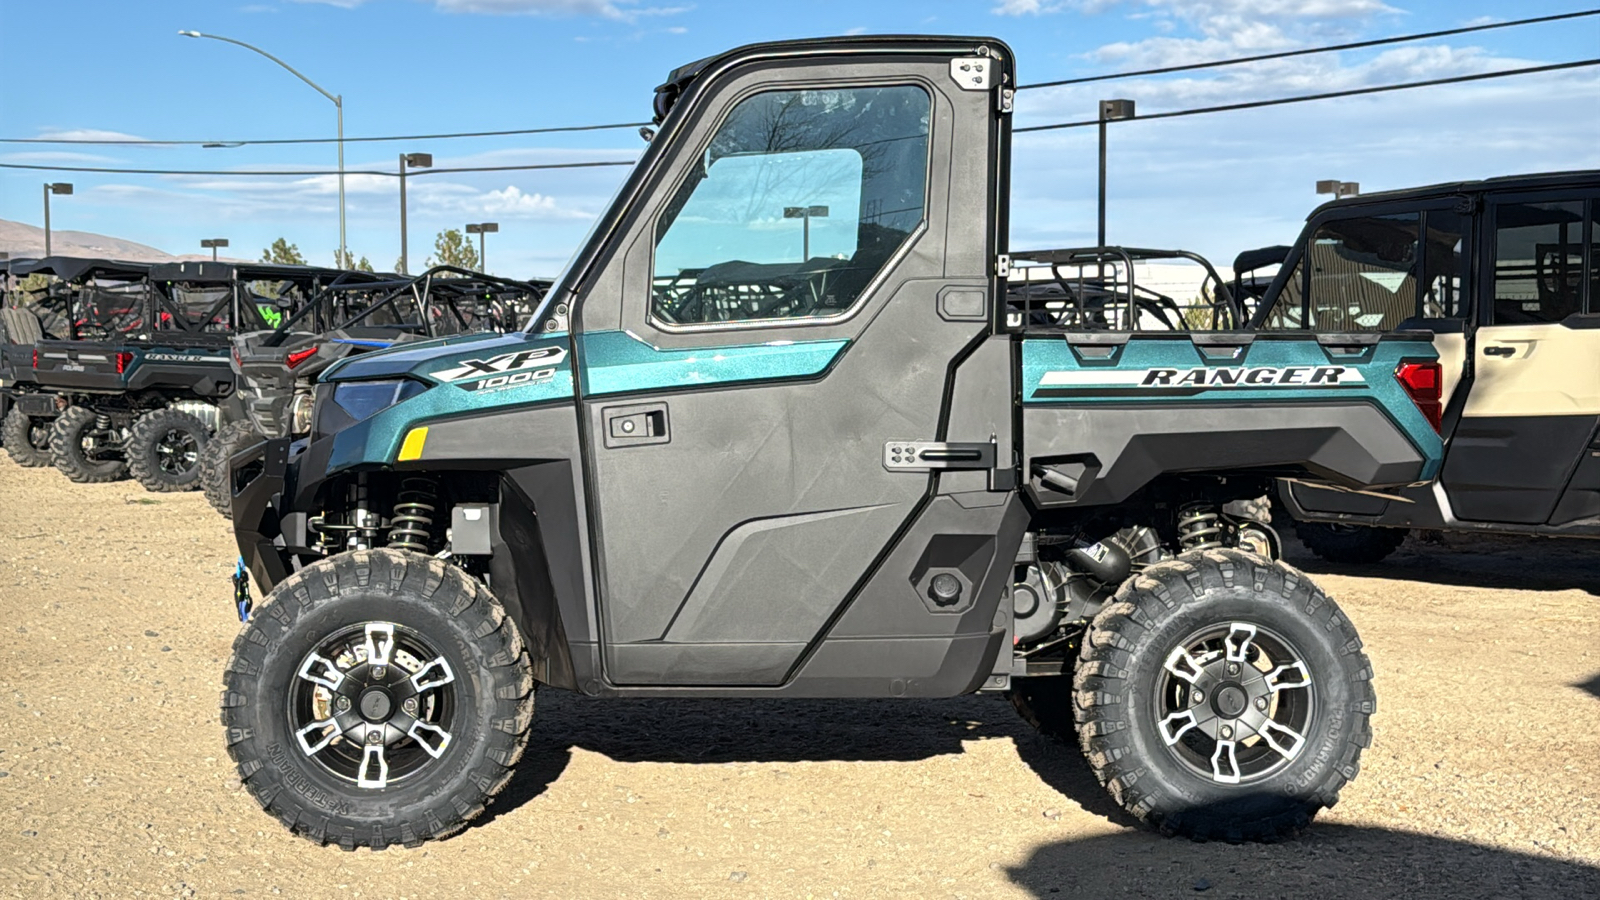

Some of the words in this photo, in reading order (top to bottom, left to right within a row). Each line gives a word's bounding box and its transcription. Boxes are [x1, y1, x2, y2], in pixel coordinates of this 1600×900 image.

[147, 353, 202, 362] RANGER
[448, 346, 564, 380] XP
[476, 368, 556, 389] 1000
[1139, 366, 1346, 387] RANGER
[266, 742, 350, 816] X-TERRAIN
